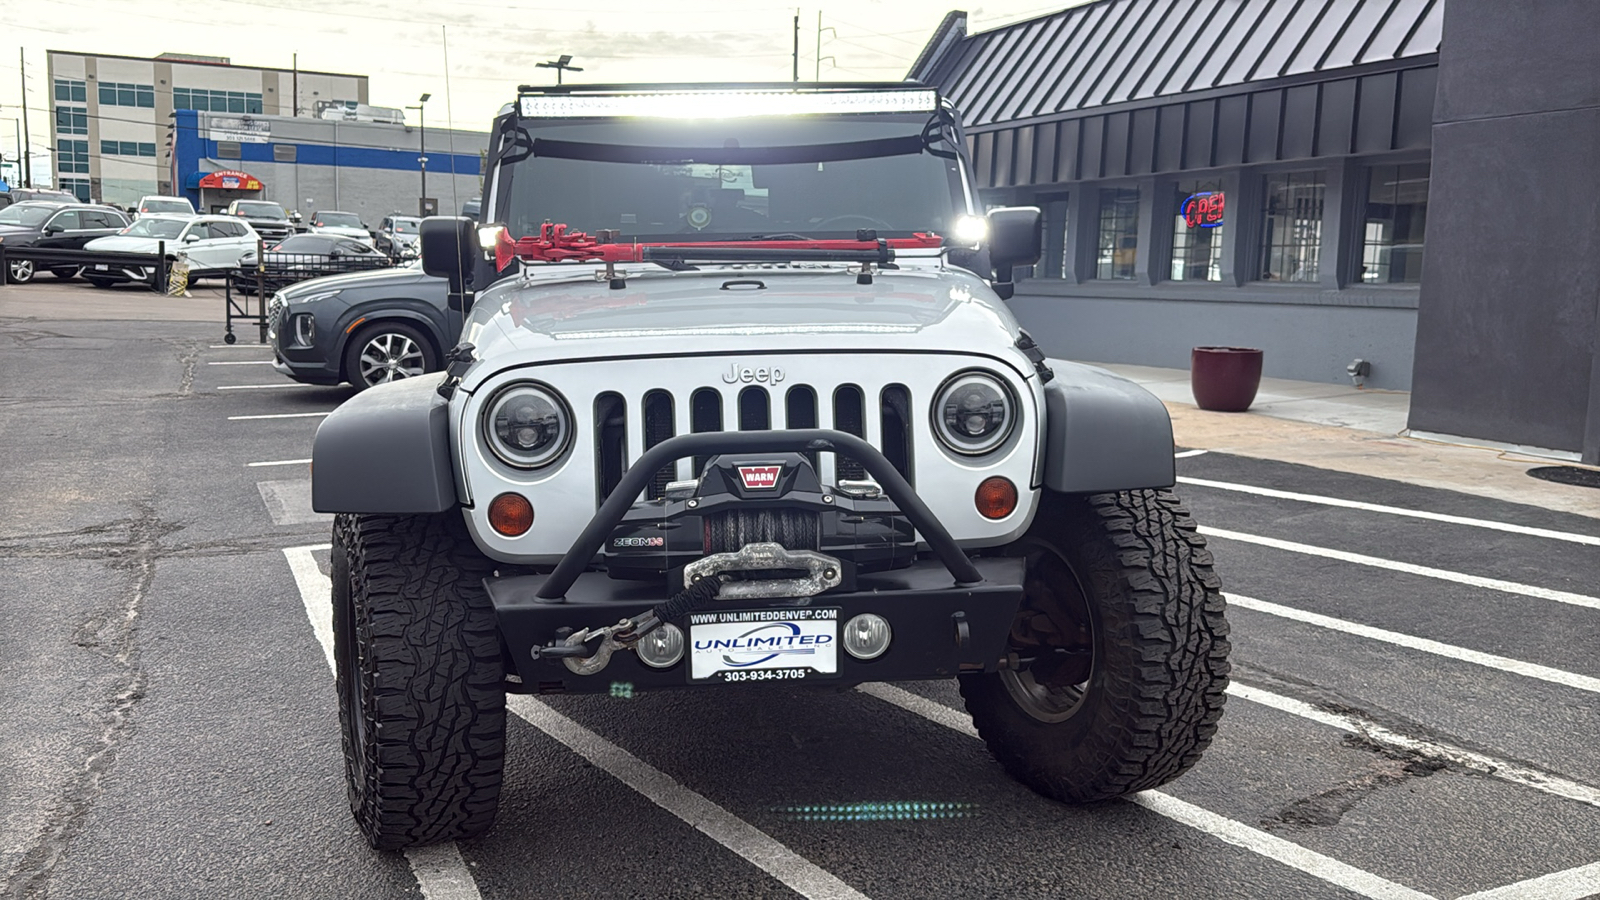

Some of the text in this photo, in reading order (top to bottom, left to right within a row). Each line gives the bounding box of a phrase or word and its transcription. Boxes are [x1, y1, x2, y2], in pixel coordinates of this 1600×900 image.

[214, 170, 248, 179] ENTRANCE
[722, 363, 786, 387] Jeep
[746, 473, 774, 482] WARN
[694, 634, 833, 650] UNLIMITED
[724, 669, 806, 682] 303-934-3705
